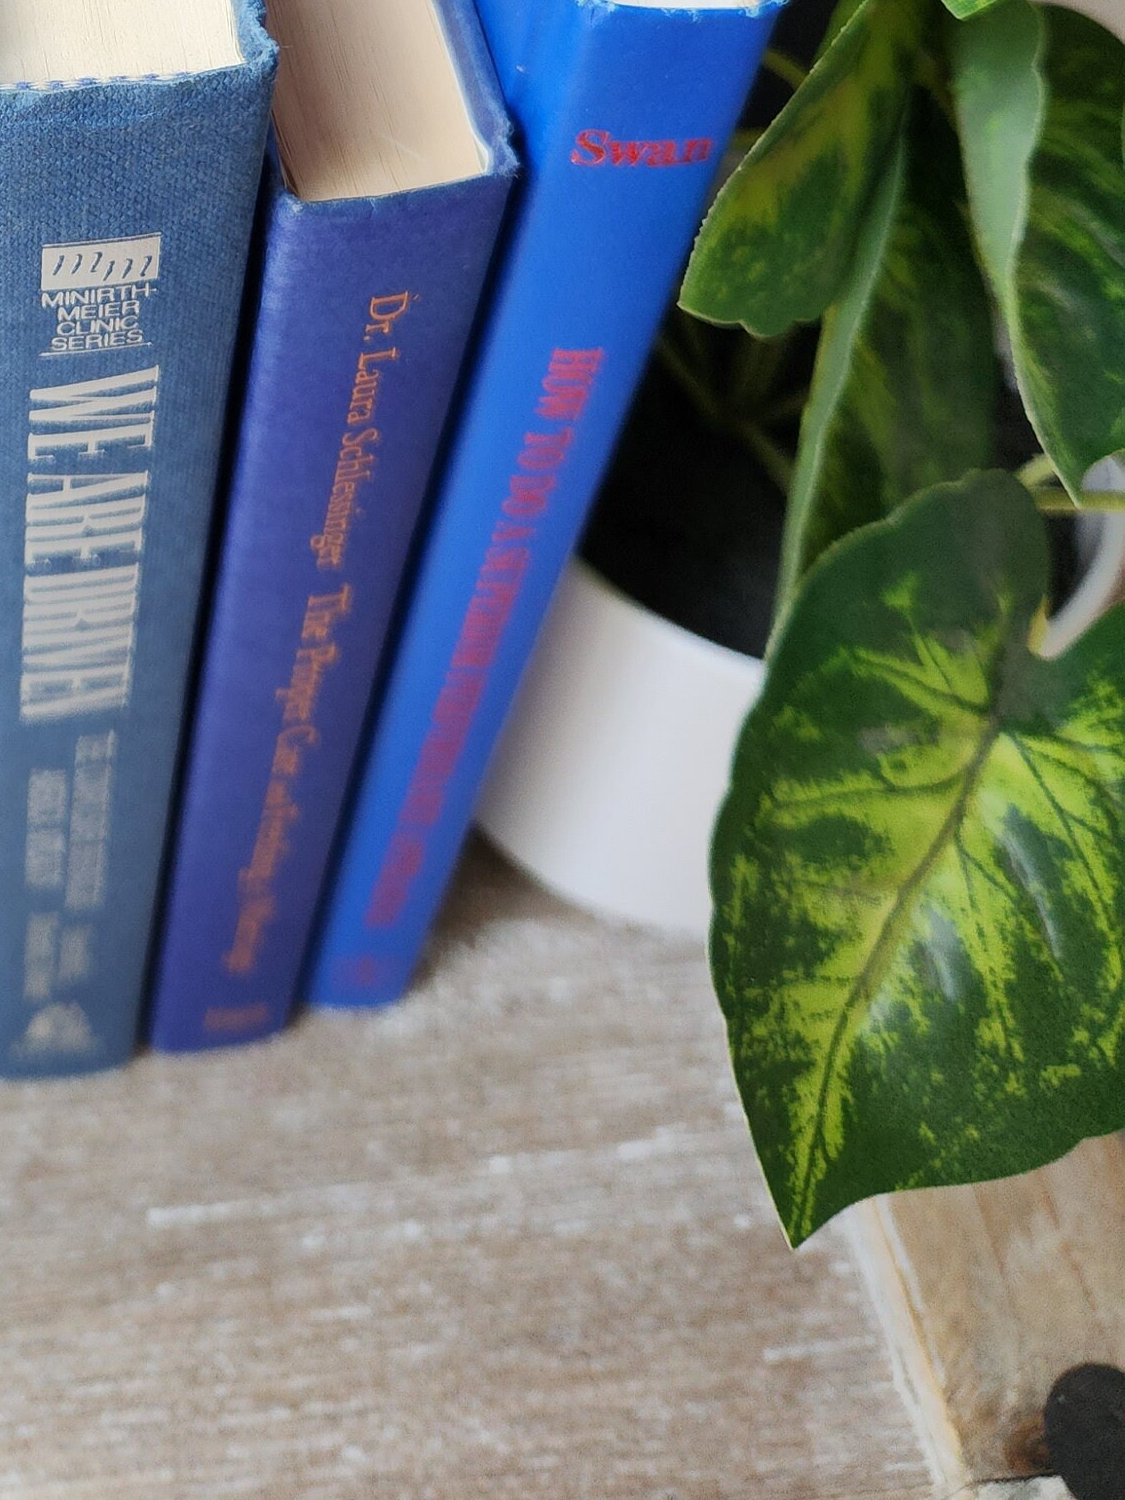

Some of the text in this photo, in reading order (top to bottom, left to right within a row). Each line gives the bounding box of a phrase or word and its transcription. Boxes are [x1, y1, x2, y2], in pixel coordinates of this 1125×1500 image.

[570, 128, 713, 168] Swan
[41, 281, 158, 309] MINIRTH-
[57, 299, 140, 323] MEIER
[363, 291, 411, 342] Dr.
[51, 329, 143, 352] SERIES
[56, 315, 140, 337] CLINIC
[346, 346, 400, 426] Laura
[533, 346, 603, 421] HOW
[27, 364, 159, 462] WE
[516, 426, 573, 471] TO
[25, 470, 149, 566] ARE
[501, 474, 557, 518] DO
[19, 560, 140, 725] DRIVEN
